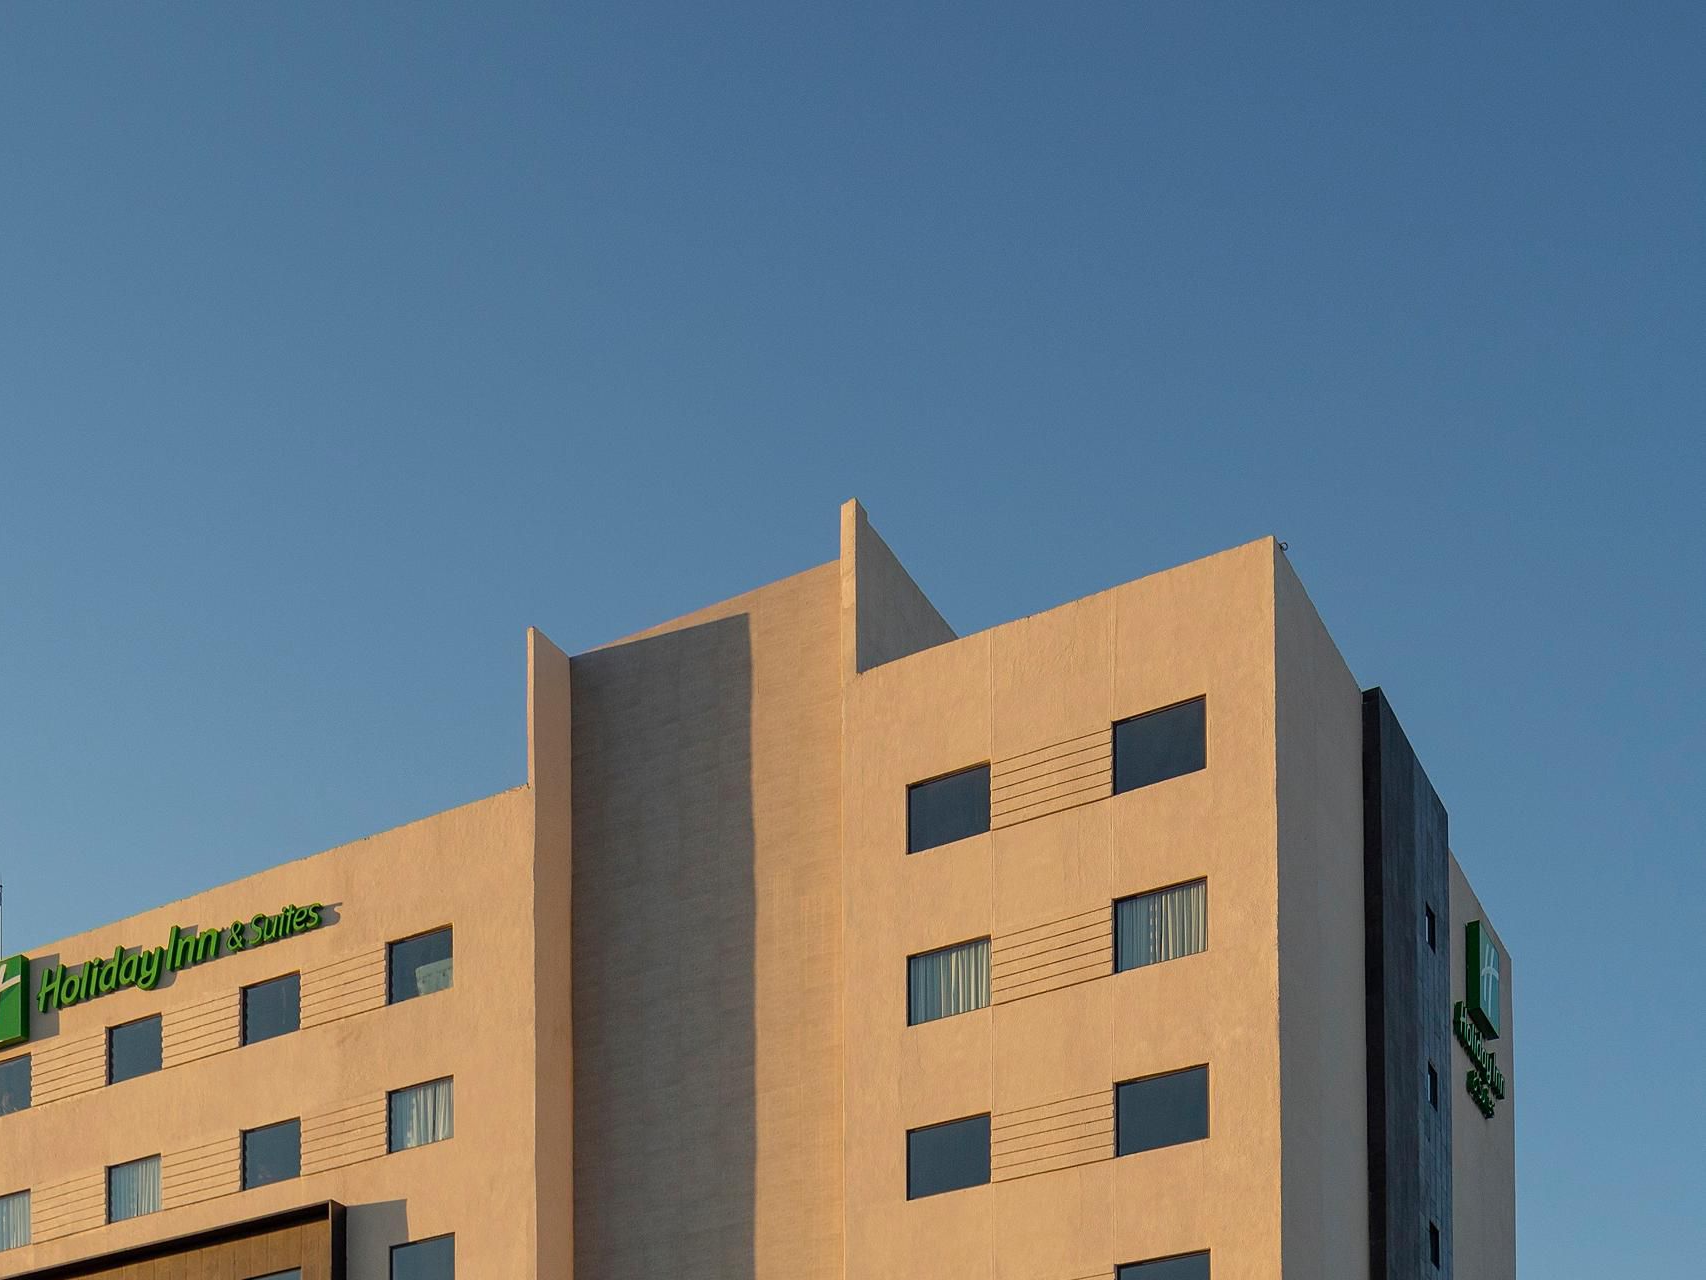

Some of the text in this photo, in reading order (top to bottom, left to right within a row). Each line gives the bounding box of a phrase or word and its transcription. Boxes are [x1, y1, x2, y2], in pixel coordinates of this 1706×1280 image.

[36, 902, 324, 1013] Holiday Inn & Suites
[1456, 1001, 1493, 1085] Holiday
